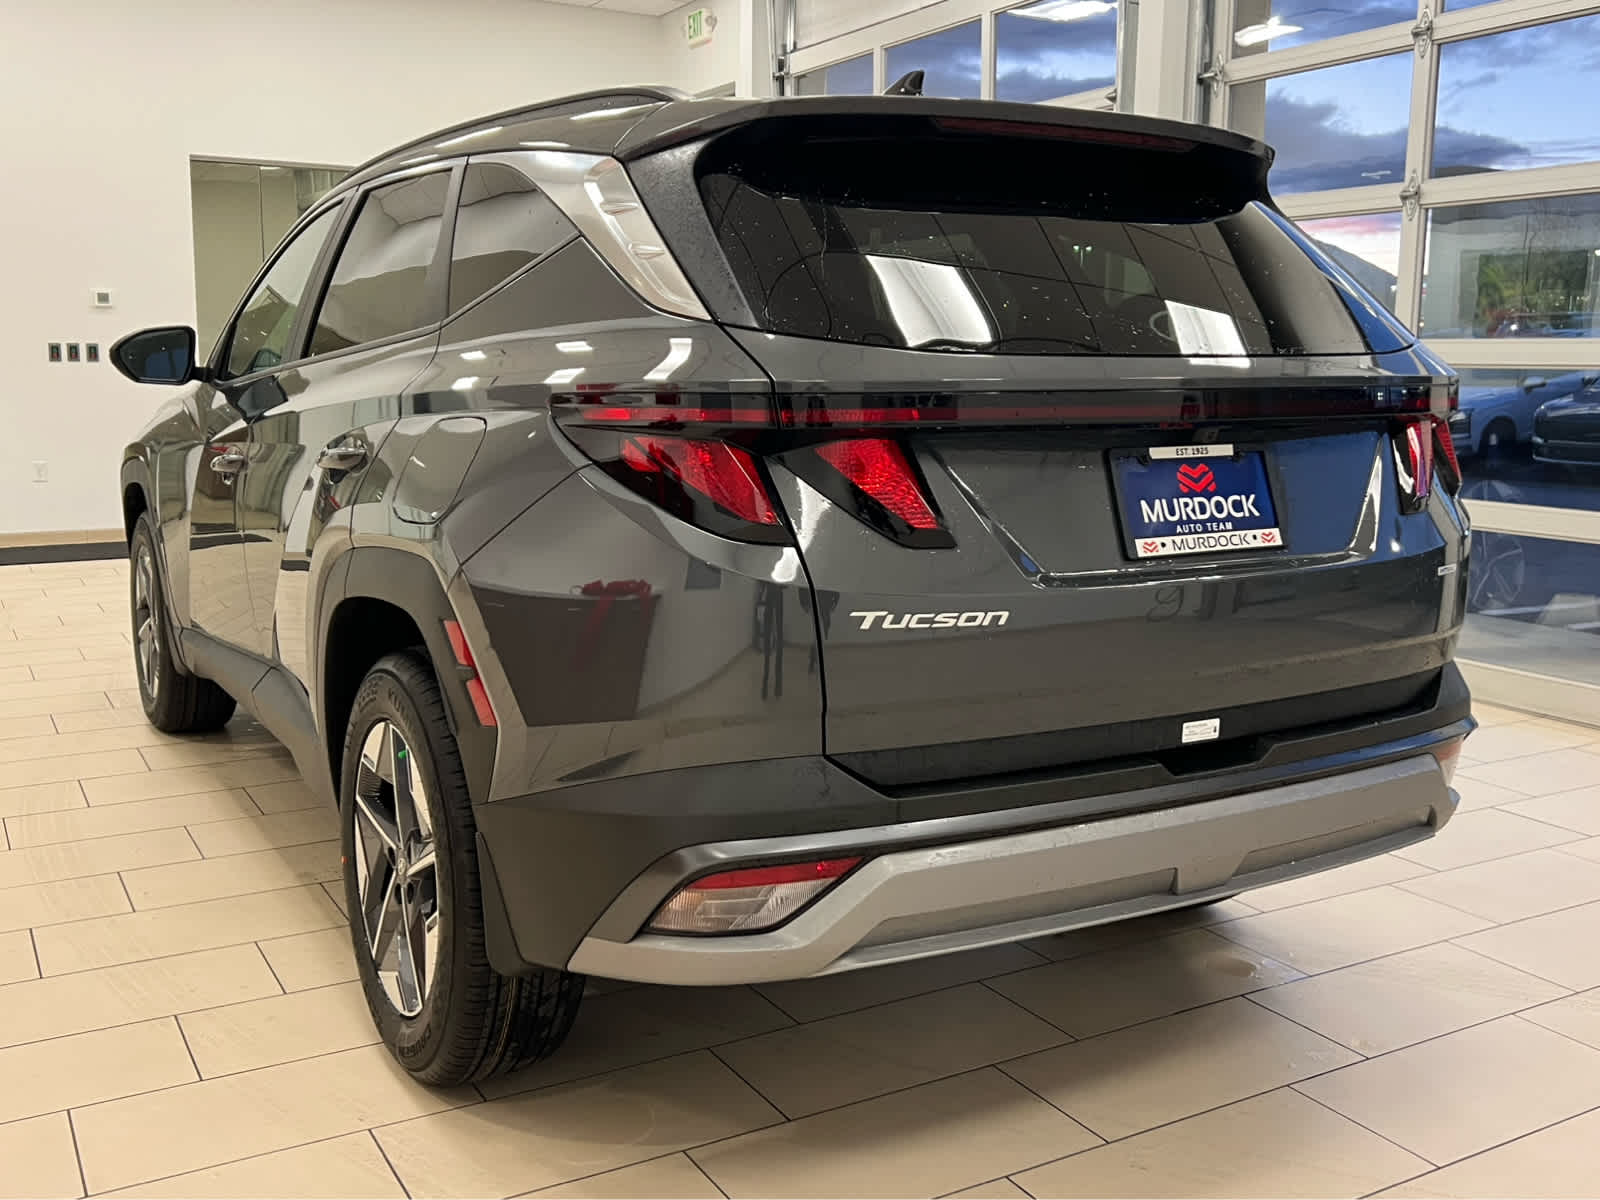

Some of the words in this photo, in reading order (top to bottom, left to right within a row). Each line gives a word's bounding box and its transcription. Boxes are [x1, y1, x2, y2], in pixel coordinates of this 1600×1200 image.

[688, 11, 702, 39] EXIT
[1191, 447, 1209, 455] 1925
[1140, 494, 1260, 523] MURDOCK
[1176, 524, 1203, 533] AUTO
[1206, 522, 1233, 531] TEAM
[1172, 534, 1250, 552] MURDOCK
[849, 611, 1009, 629] Tucson
